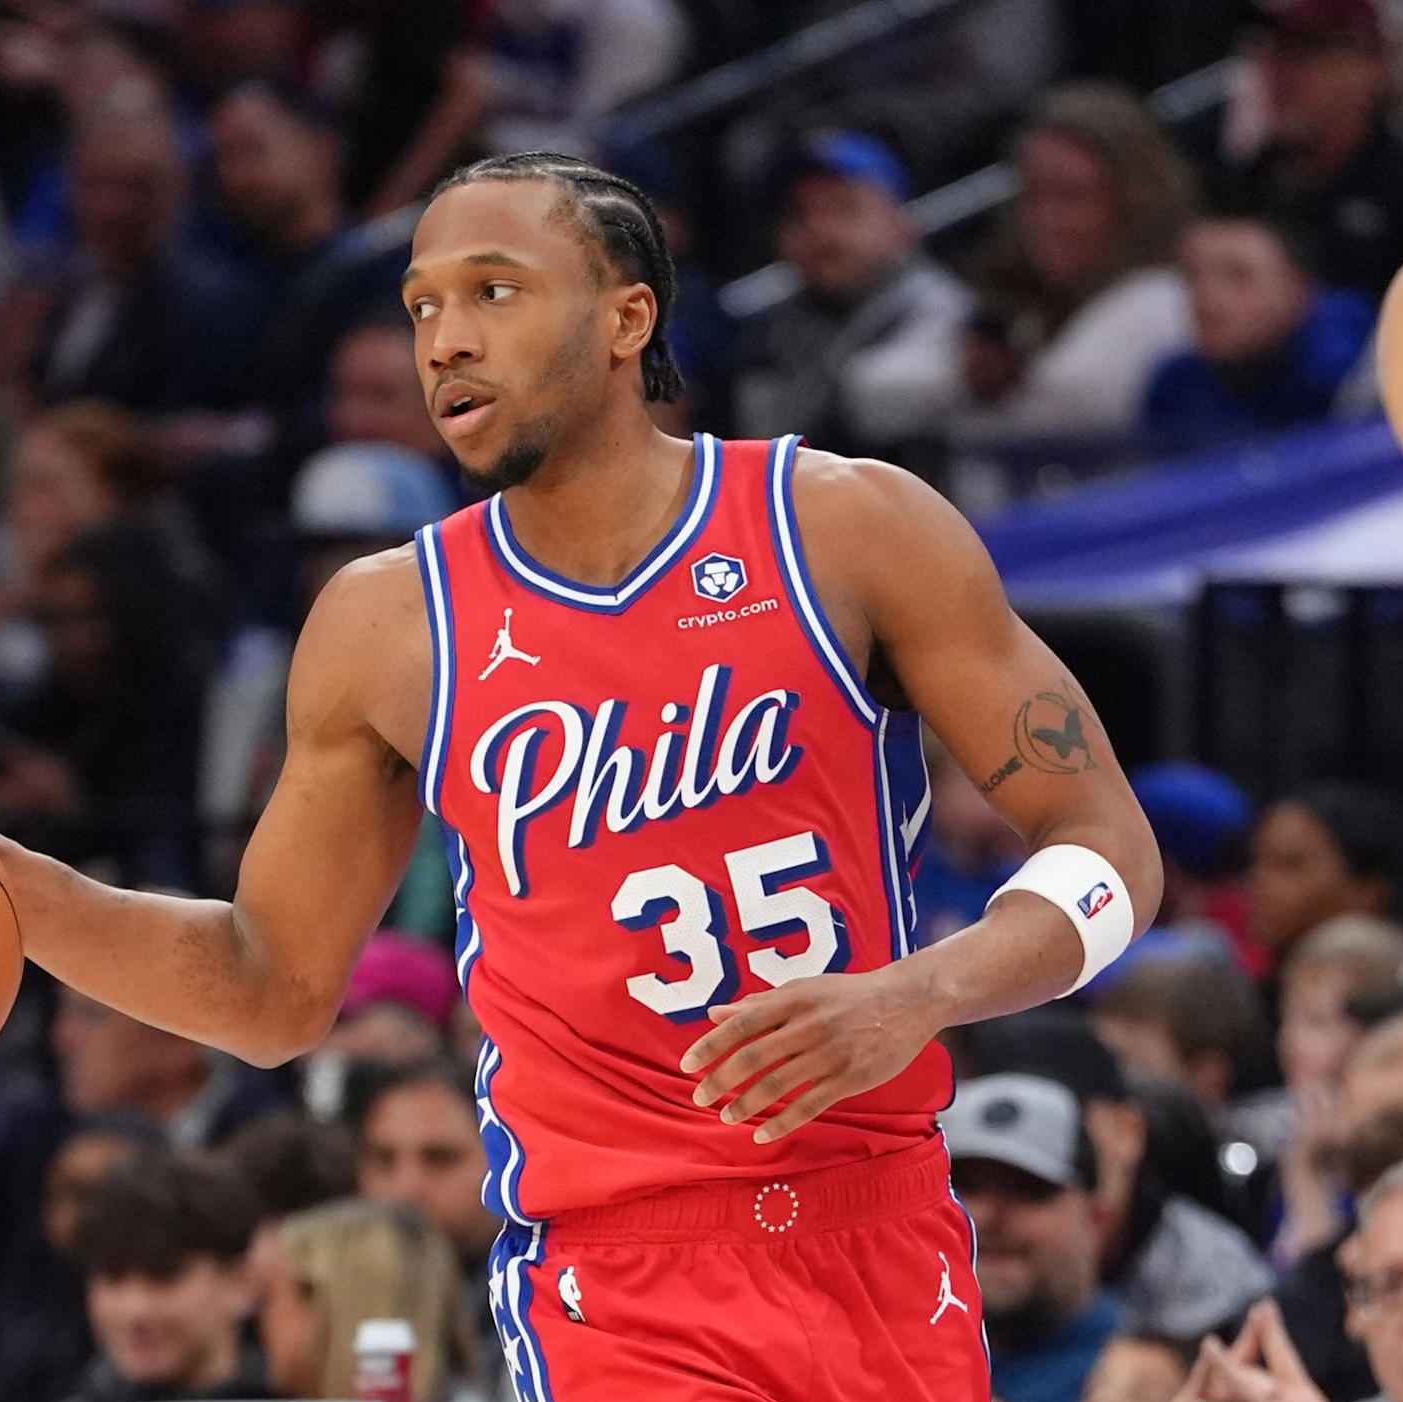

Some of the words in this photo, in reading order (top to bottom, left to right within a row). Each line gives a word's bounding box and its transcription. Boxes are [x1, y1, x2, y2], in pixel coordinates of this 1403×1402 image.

[677, 598, 779, 630] crypto.com
[470, 664, 804, 898] Phila
[611, 831, 850, 1023] 35
